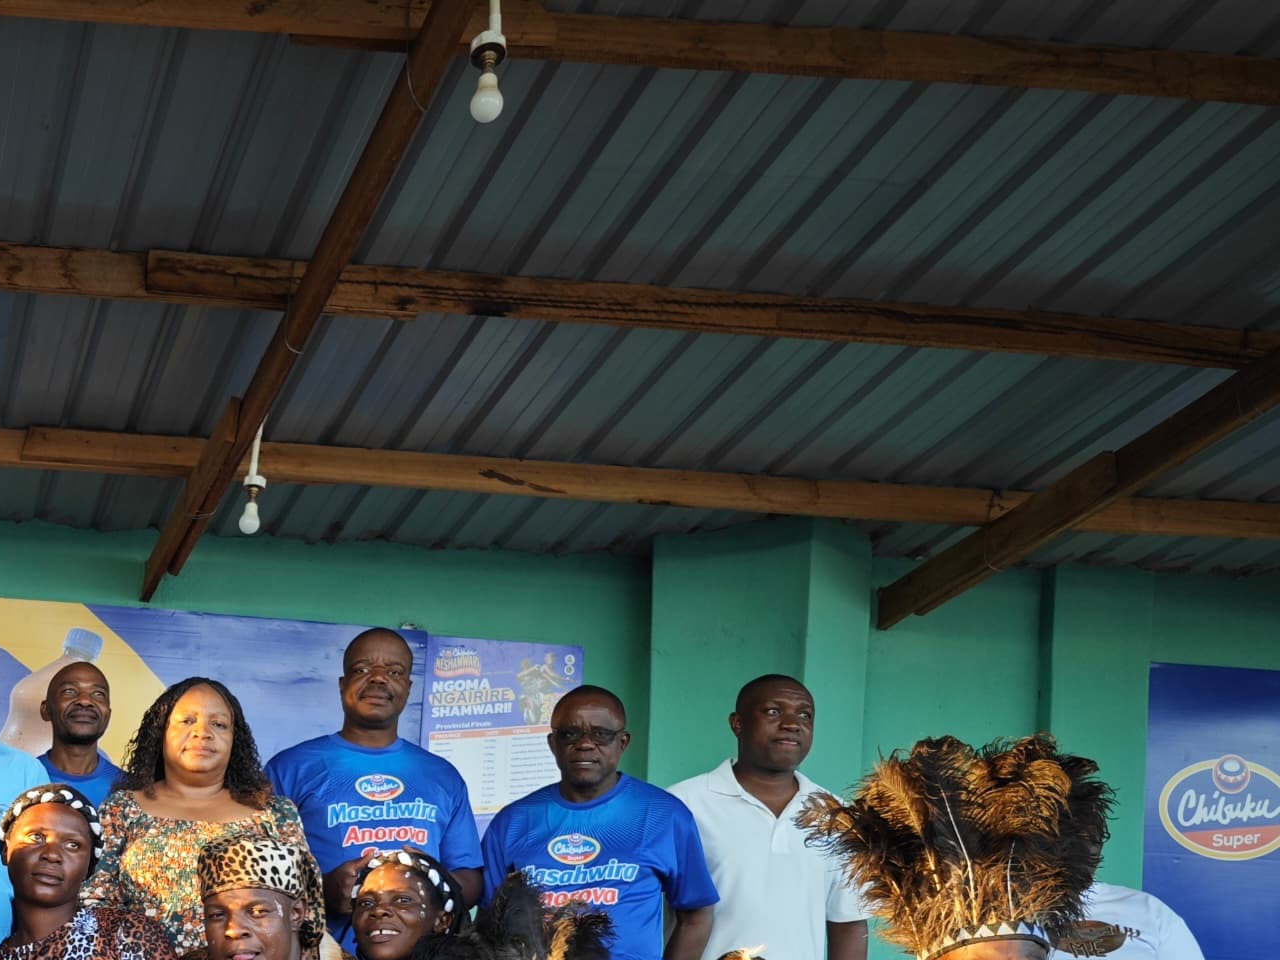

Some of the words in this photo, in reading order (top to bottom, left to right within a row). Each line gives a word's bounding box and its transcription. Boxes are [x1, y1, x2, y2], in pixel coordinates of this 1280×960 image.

[432, 678, 490, 693] NGOMA
[431, 689, 510, 705] NGAIRIRE
[327, 797, 438, 828] Masahwira
[1177, 788, 1280, 827] Chibuku
[342, 825, 428, 847] Anorova
[1212, 832, 1261, 849] Super
[540, 887, 619, 908] norova
